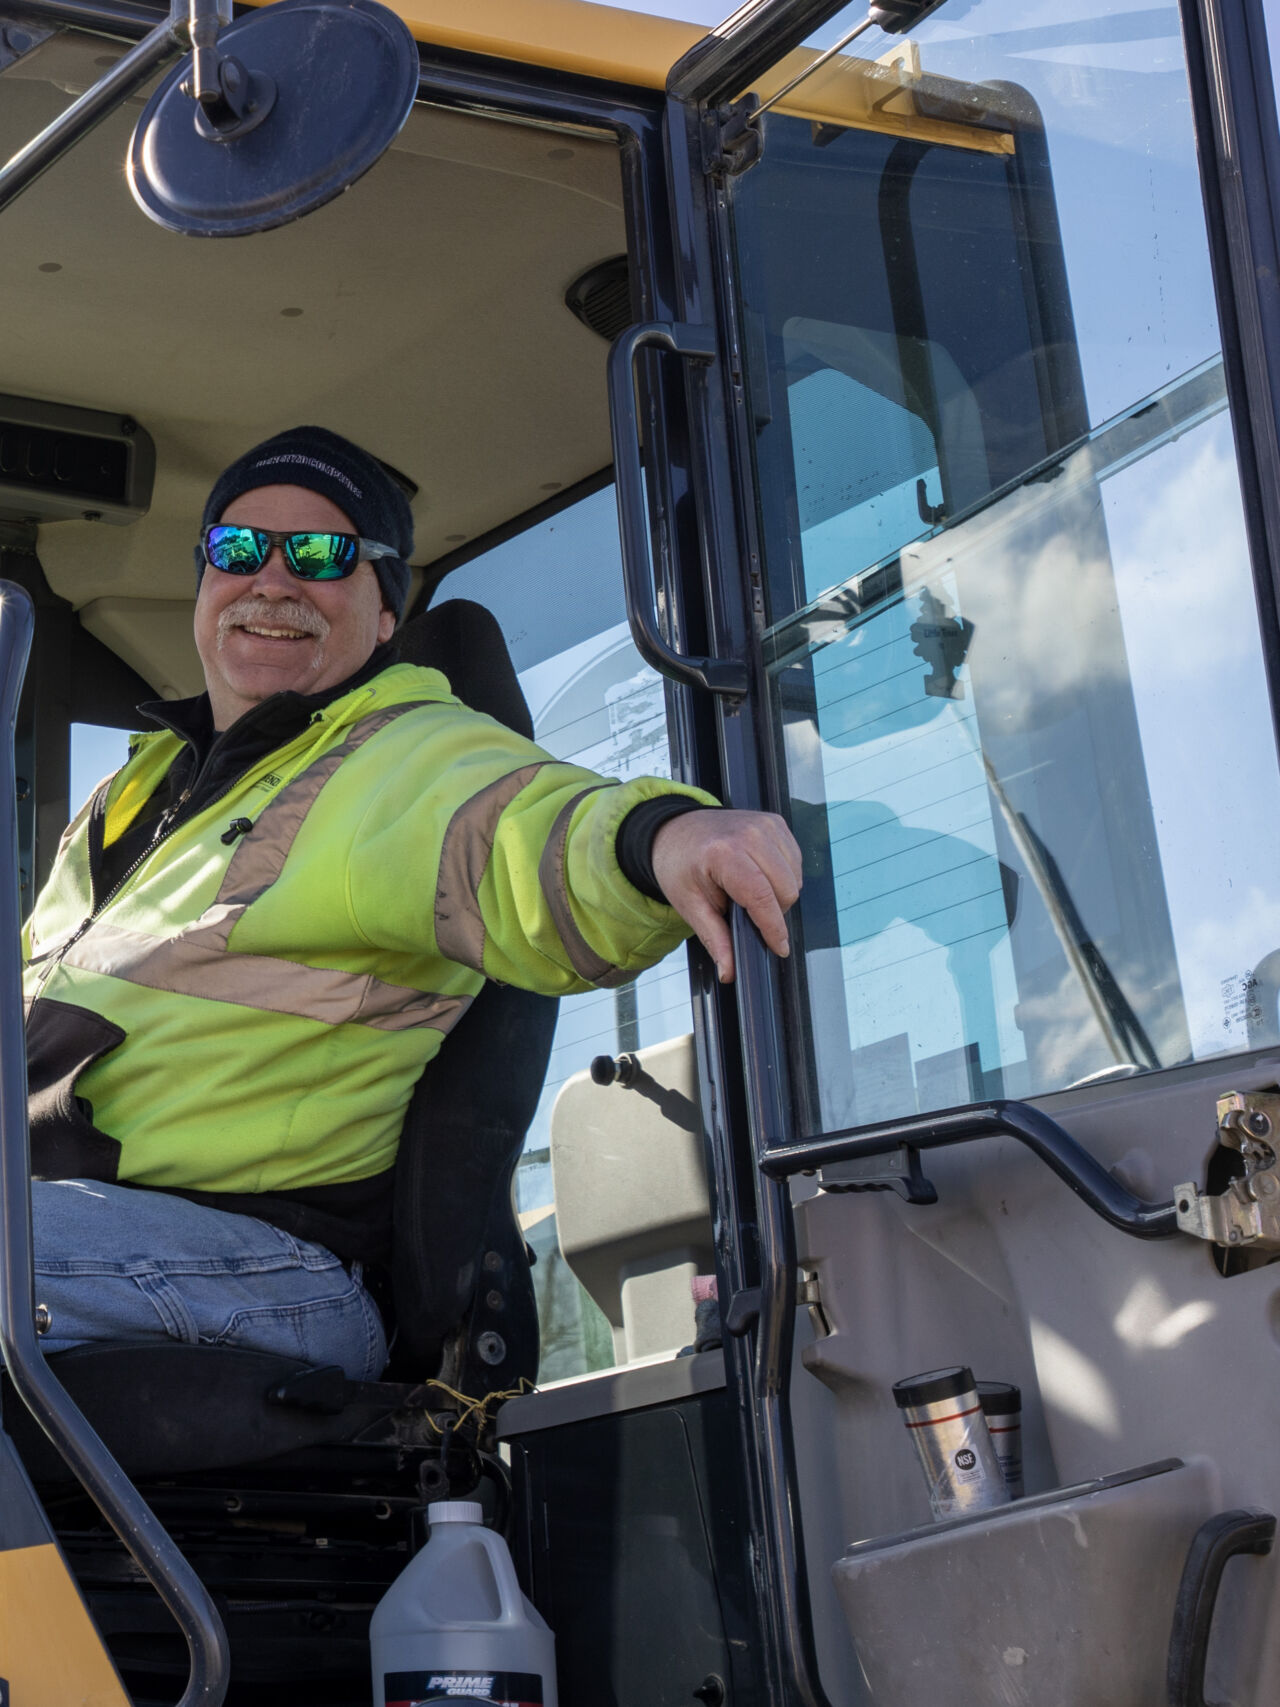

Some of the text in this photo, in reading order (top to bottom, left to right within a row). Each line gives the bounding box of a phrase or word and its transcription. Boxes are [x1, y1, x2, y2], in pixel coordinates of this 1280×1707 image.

[957, 1453, 974, 1467] NSF
[427, 1676, 494, 1689] PRIME
[446, 1688, 491, 1697] GUARD
